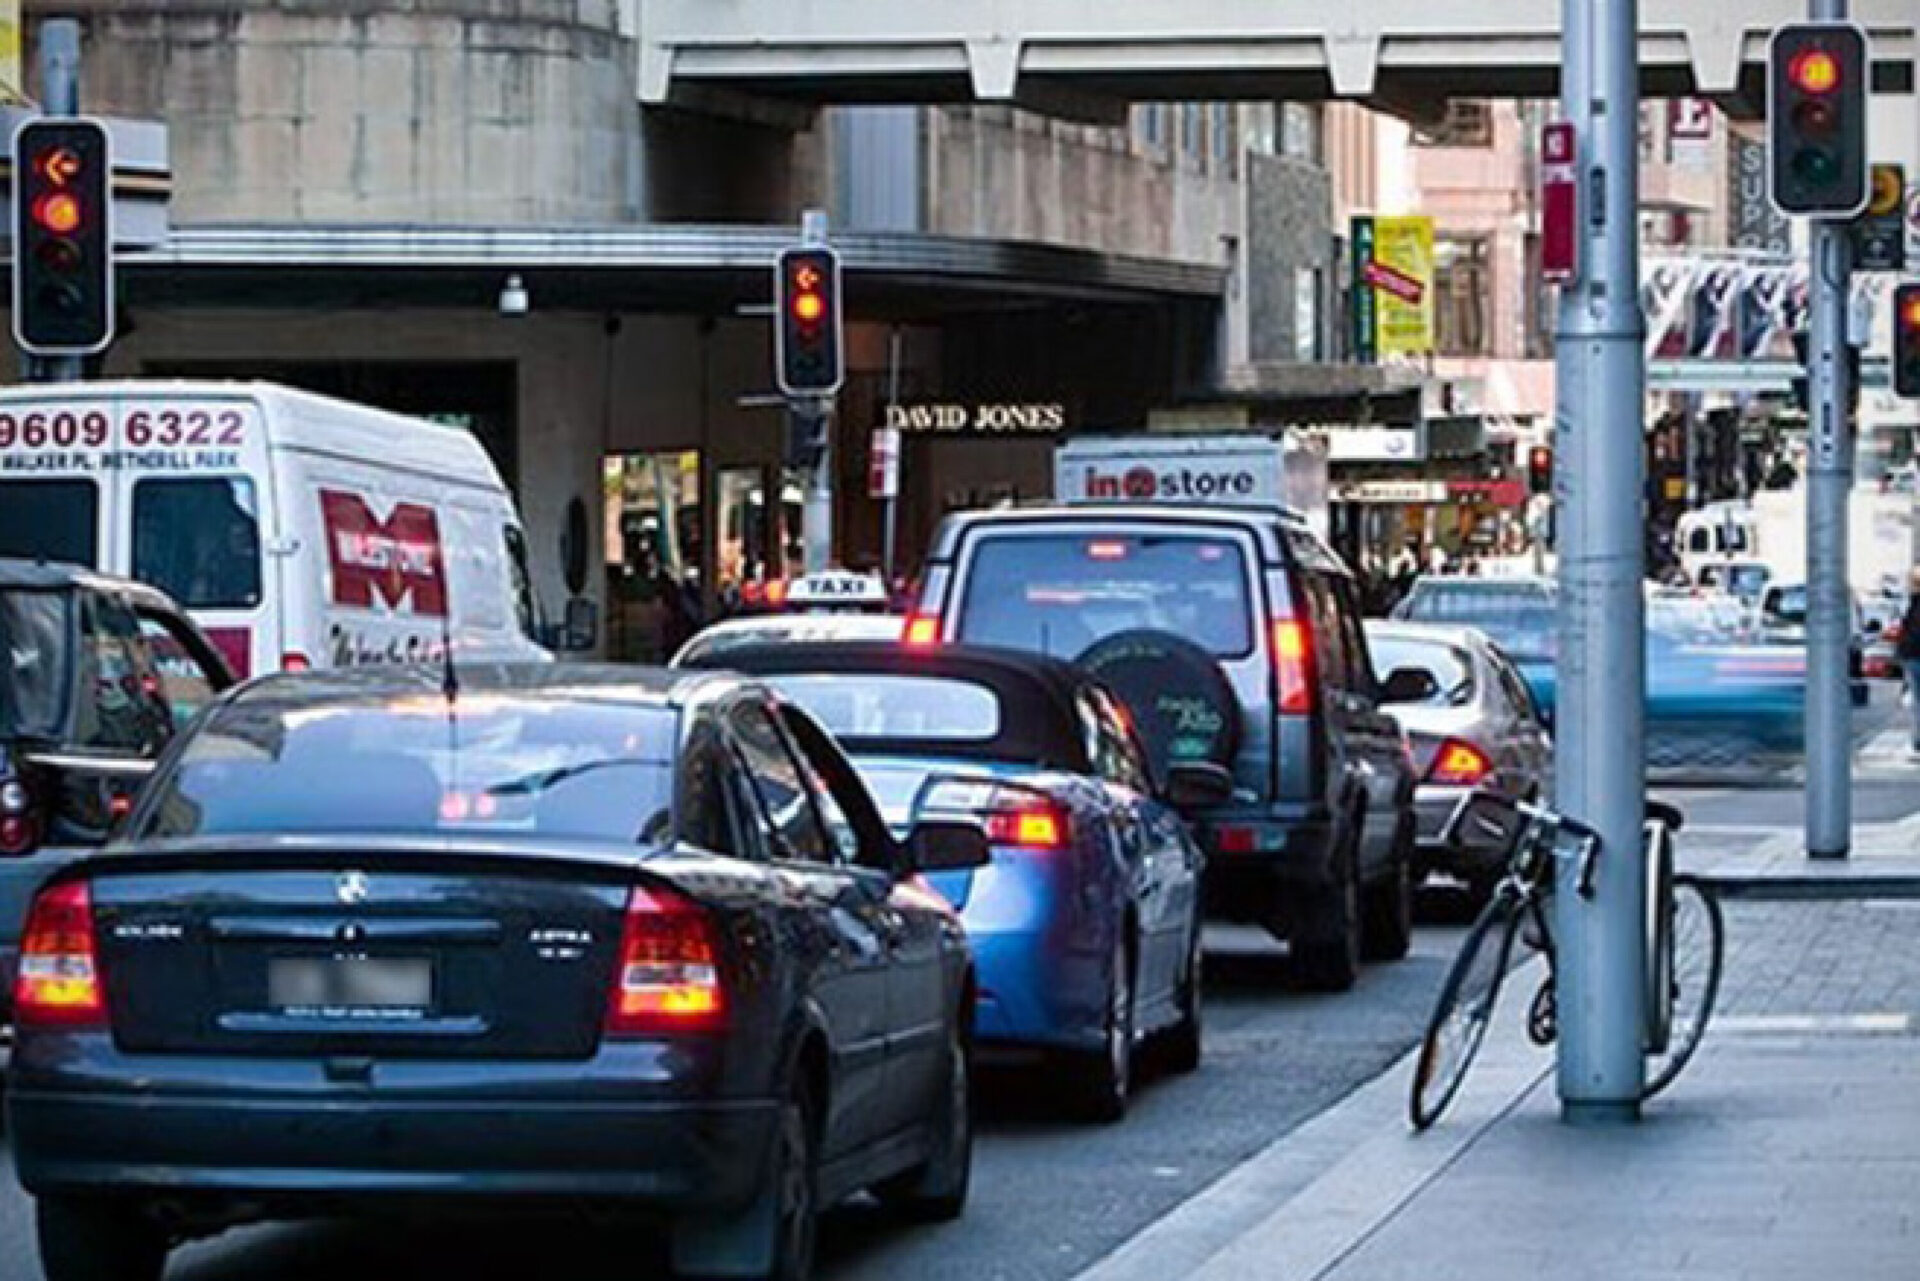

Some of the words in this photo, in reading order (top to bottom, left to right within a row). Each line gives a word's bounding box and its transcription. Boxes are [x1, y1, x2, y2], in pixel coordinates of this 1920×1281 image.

[0, 412, 108, 448] 9609
[125, 410, 244, 447] 6322
[886, 404, 968, 431] DAVID
[974, 403, 1065, 432] JONES
[808, 579, 865, 593] TAXI
